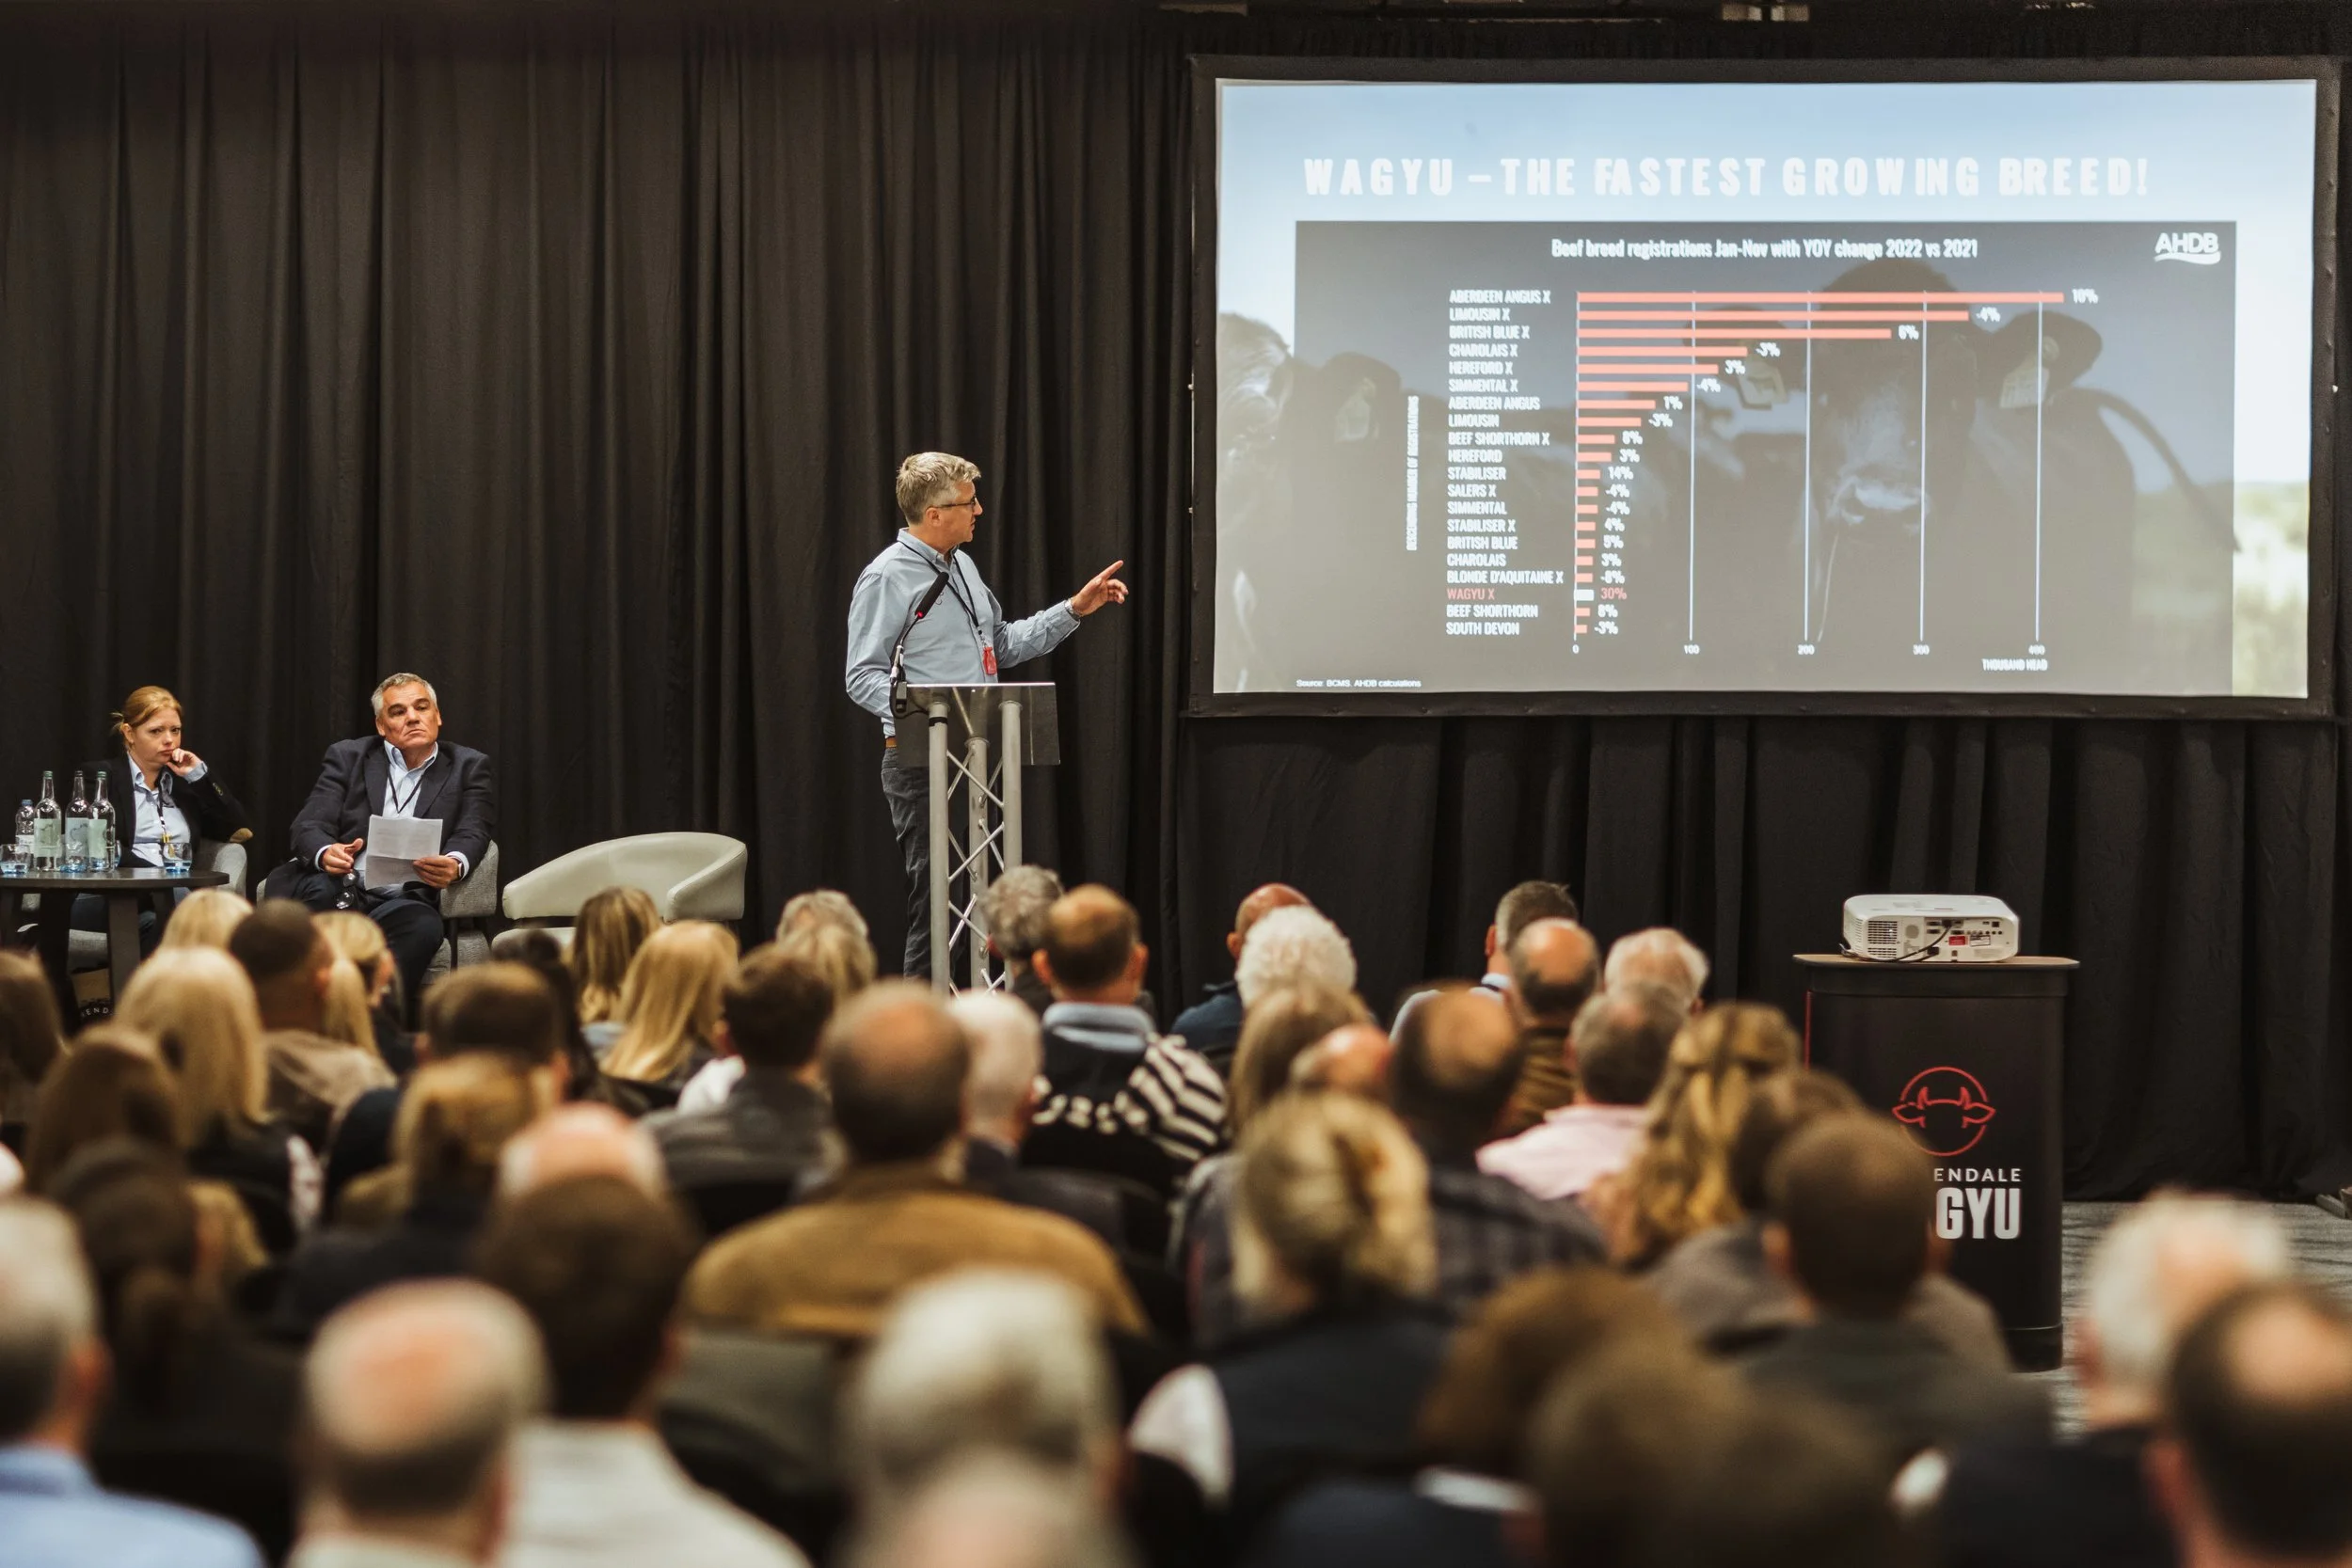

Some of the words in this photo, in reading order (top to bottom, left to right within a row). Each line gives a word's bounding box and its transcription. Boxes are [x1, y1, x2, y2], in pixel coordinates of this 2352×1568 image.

[1303, 158, 1453, 197] WAGYU
[1501, 158, 1576, 197] THE
[1595, 158, 1765, 196] FASTEST
[1783, 157, 1979, 197] GROWING
[1999, 157, 2149, 196] BREED!
[1551, 239, 1583, 258] Beef
[1585, 239, 1624, 258] breed
[1627, 239, 1712, 260] registrations
[1714, 239, 1769, 258] Jan-Nov
[1770, 240, 1800, 258] with
[1803, 240, 1832, 258] YOY
[1834, 240, 1883, 261] change
[1885, 240, 1923, 258] 2022
[1925, 244, 1941, 258] vs
[1943, 240, 1979, 258] 2021
[2154, 232, 2219, 255] AHDB
[1449, 290, 1503, 304] ABERDEEN
[1504, 290, 1542, 304] ANGUS
[1542, 290, 1550, 304] X
[1450, 308, 1501, 322] LIMOUSIN
[1502, 308, 1510, 322] X
[1449, 325, 1491, 340] BRITISH
[1493, 325, 1522, 340] BLUE
[1521, 325, 1530, 340] X
[1449, 344, 1508, 357] CHAROLAIS
[1509, 344, 1518, 357] X
[1449, 361, 1503, 374] HEREFORD
[1504, 361, 1513, 374] X
[1449, 379, 1508, 393] SIMMENTAL
[1510, 379, 1518, 393] X
[1449, 397, 1502, 410] ABERDEEN
[1503, 397, 1540, 410] ANGUS
[1663, 396, 1683, 410] 1%
[1448, 414, 1500, 427] LIMOUSIN
[1448, 432, 1473, 445] BEEF
[1475, 432, 1541, 445] SHORTHORN
[1542, 432, 1549, 445] X
[1448, 450, 1502, 463] HEREFORD
[1448, 467, 1506, 480] STABILISER
[1447, 484, 1486, 498] SALERS
[1487, 484, 1496, 498] X
[1447, 501, 1507, 515] SIMMENTAL
[1447, 519, 1506, 532] STABILISER
[1507, 519, 1516, 532] X
[1447, 536, 1489, 549] BRITISH
[1491, 536, 1518, 549] BLUE
[1447, 553, 1506, 566] CHAROLAIS
[1447, 571, 1488, 584] BLONDE
[1490, 571, 1554, 585] D'AQUITAINE
[1555, 571, 1564, 584] X
[1447, 588, 1486, 599] WAGYU
[1487, 588, 1495, 599] X
[1601, 588, 1627, 599] 30%
[1447, 605, 1471, 618] BEEF
[1473, 605, 1538, 618] SHORTHORN
[1446, 622, 1483, 636] SOUTH
[1484, 622, 1519, 636] DEVON
[1572, 644, 1580, 654] 0
[1683, 644, 1700, 655] 100
[1798, 644, 1815, 655] 200
[1913, 644, 1931, 655] 300
[2028, 644, 2045, 656] 400
[1981, 658, 2025, 672] THOUSAND
[2026, 658, 2048, 672] HEAD
[1378, 679, 1422, 688] calculations
